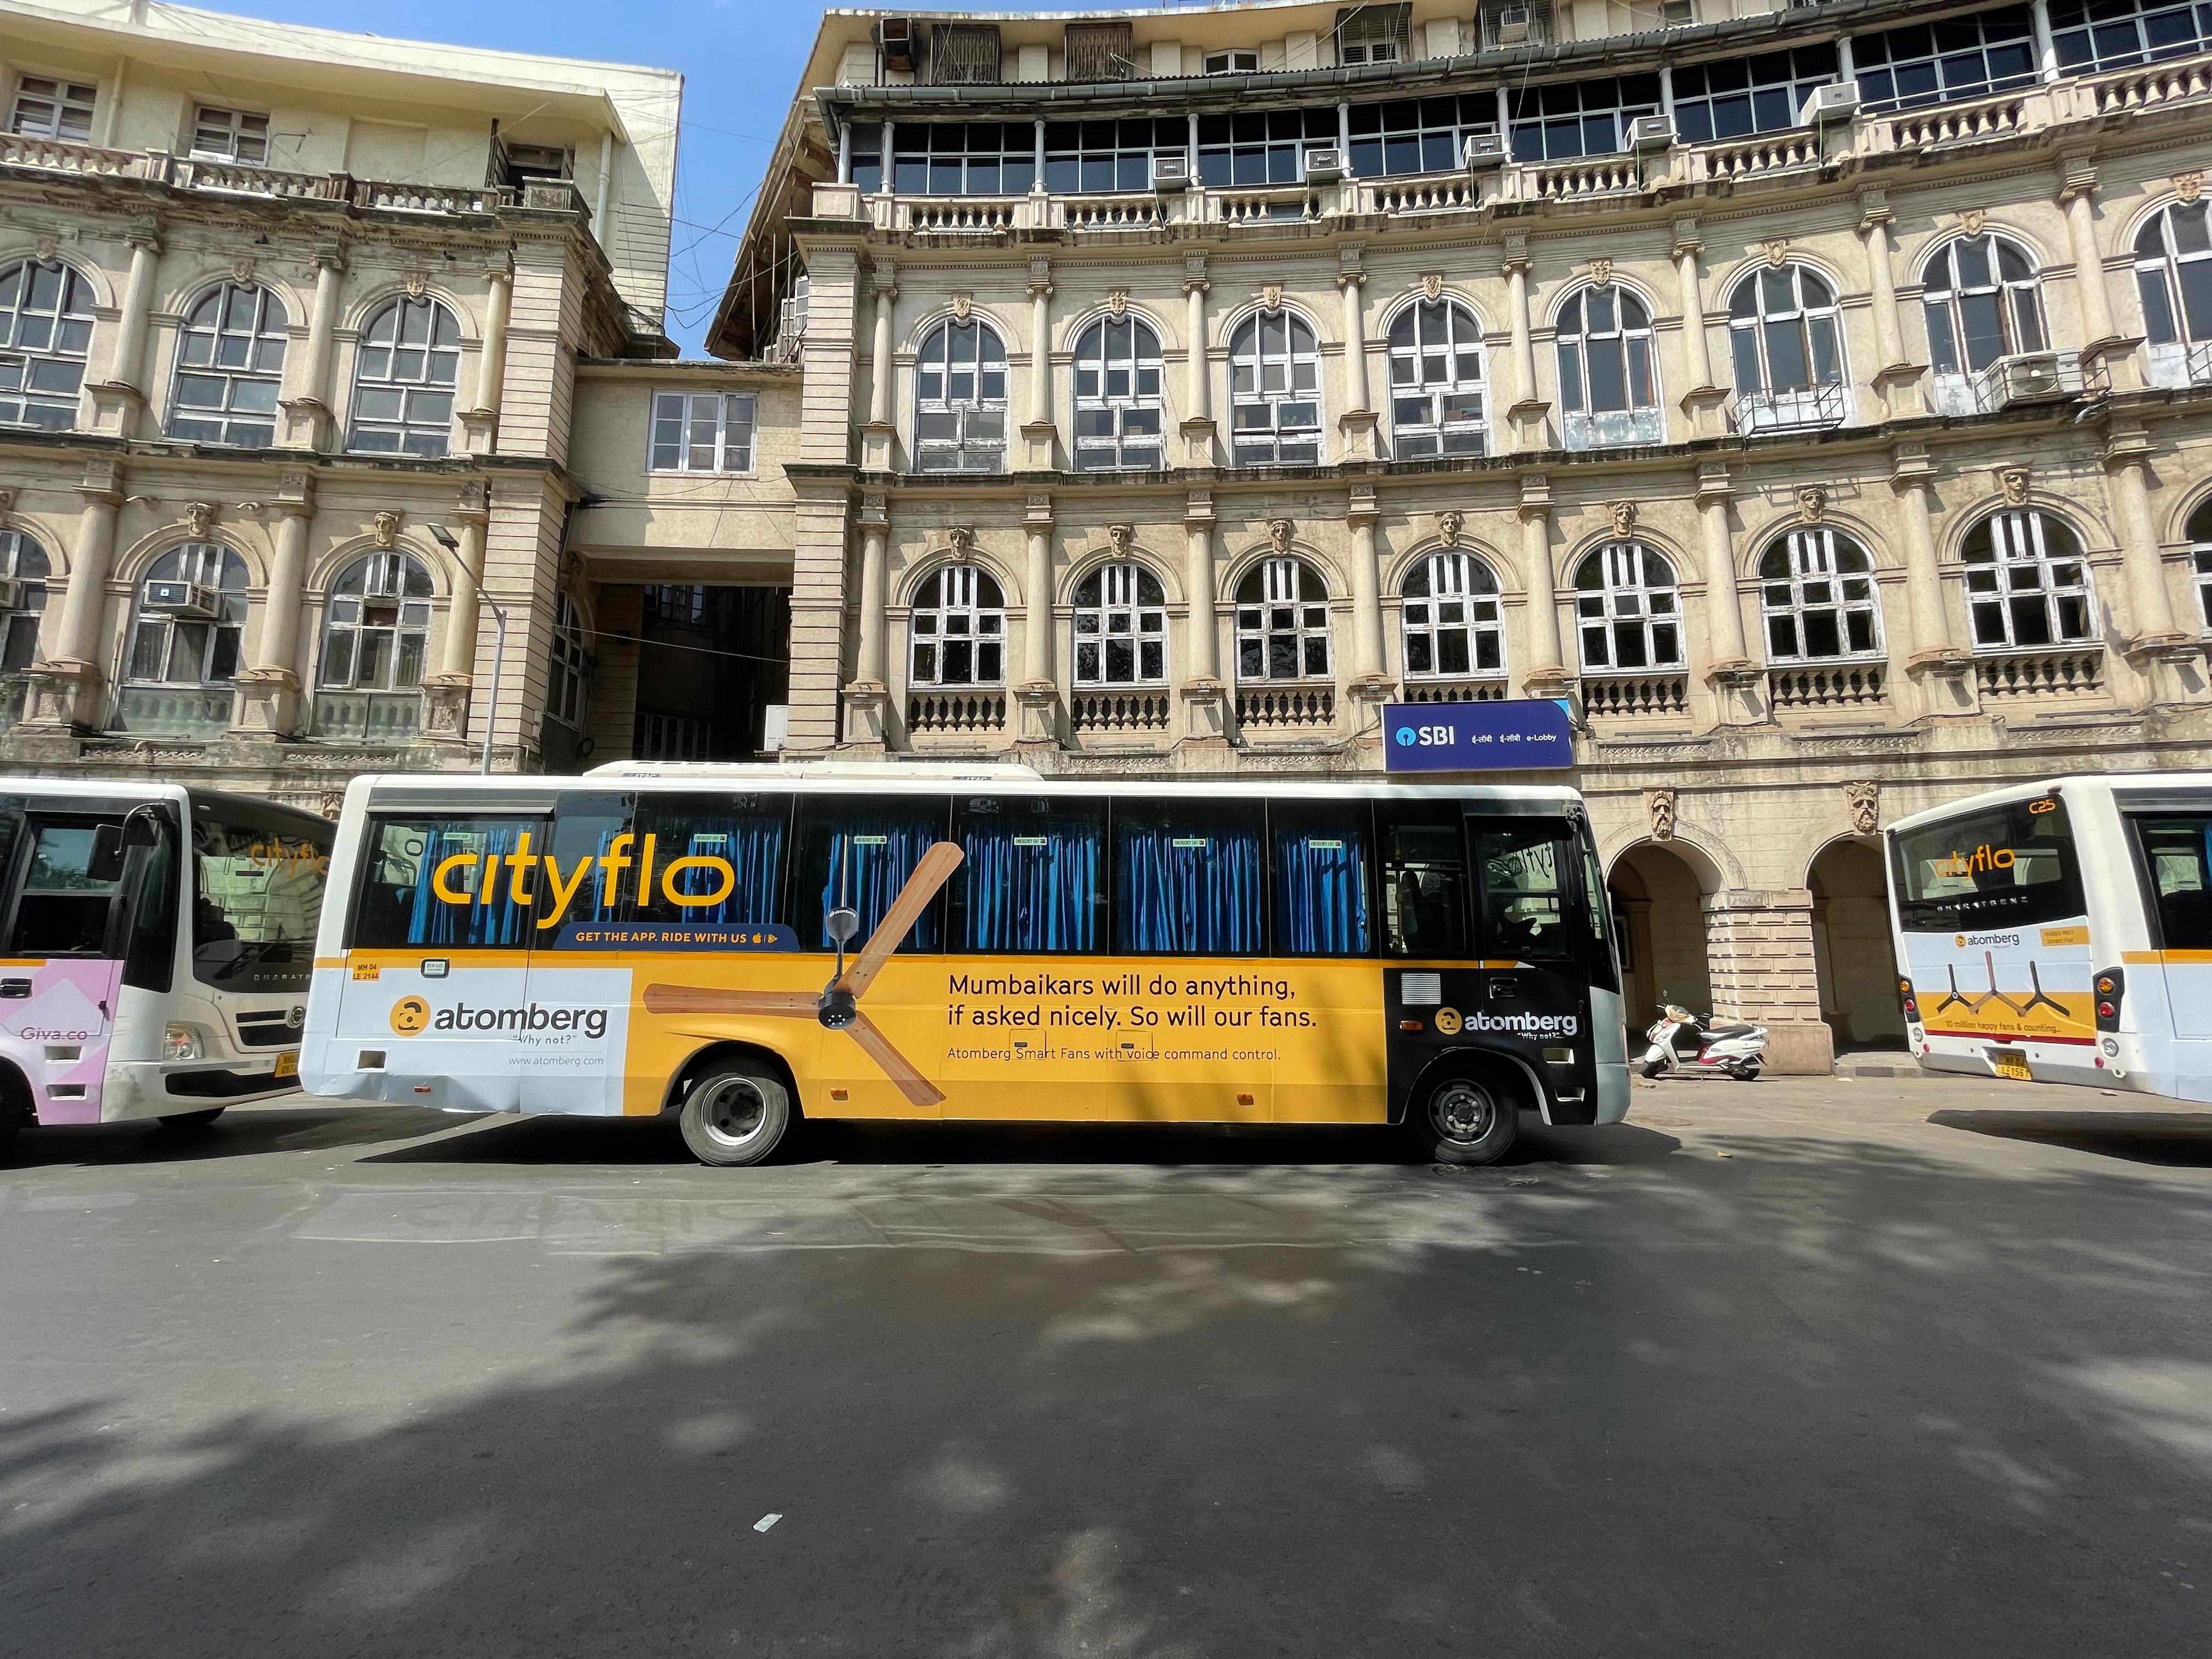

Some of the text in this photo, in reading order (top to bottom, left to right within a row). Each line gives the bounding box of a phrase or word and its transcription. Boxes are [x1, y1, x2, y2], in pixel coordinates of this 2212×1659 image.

[1418, 725, 1455, 746] SBI
[1526, 733, 1557, 742] e-Lobby
[2029, 799, 2056, 815] C25
[1934, 844, 2016, 881] cityflo
[432, 832, 735, 929] cityflo
[576, 932, 747, 943] GET THE APP. RIDE WITH US
[1967, 933, 2019, 946] atomberg
[950, 974, 1295, 1000] Mumbaikars will do anything,
[435, 1002, 608, 1039] atomberg
[949, 1005, 1317, 1030] if asked nicely. So will our fans.
[1465, 1011, 1577, 1036] atomberg
[20, 1027, 88, 1040] Giva.co
[1977, 1022, 1997, 1031] happy
[1999, 1022, 2015, 1030] fans
[2017, 1023, 2022, 1031] &
[508, 1056, 603, 1065] www.atomberg.com
[947, 1048, 1281, 1061] Atomberg Smart Fans with voice command control.
